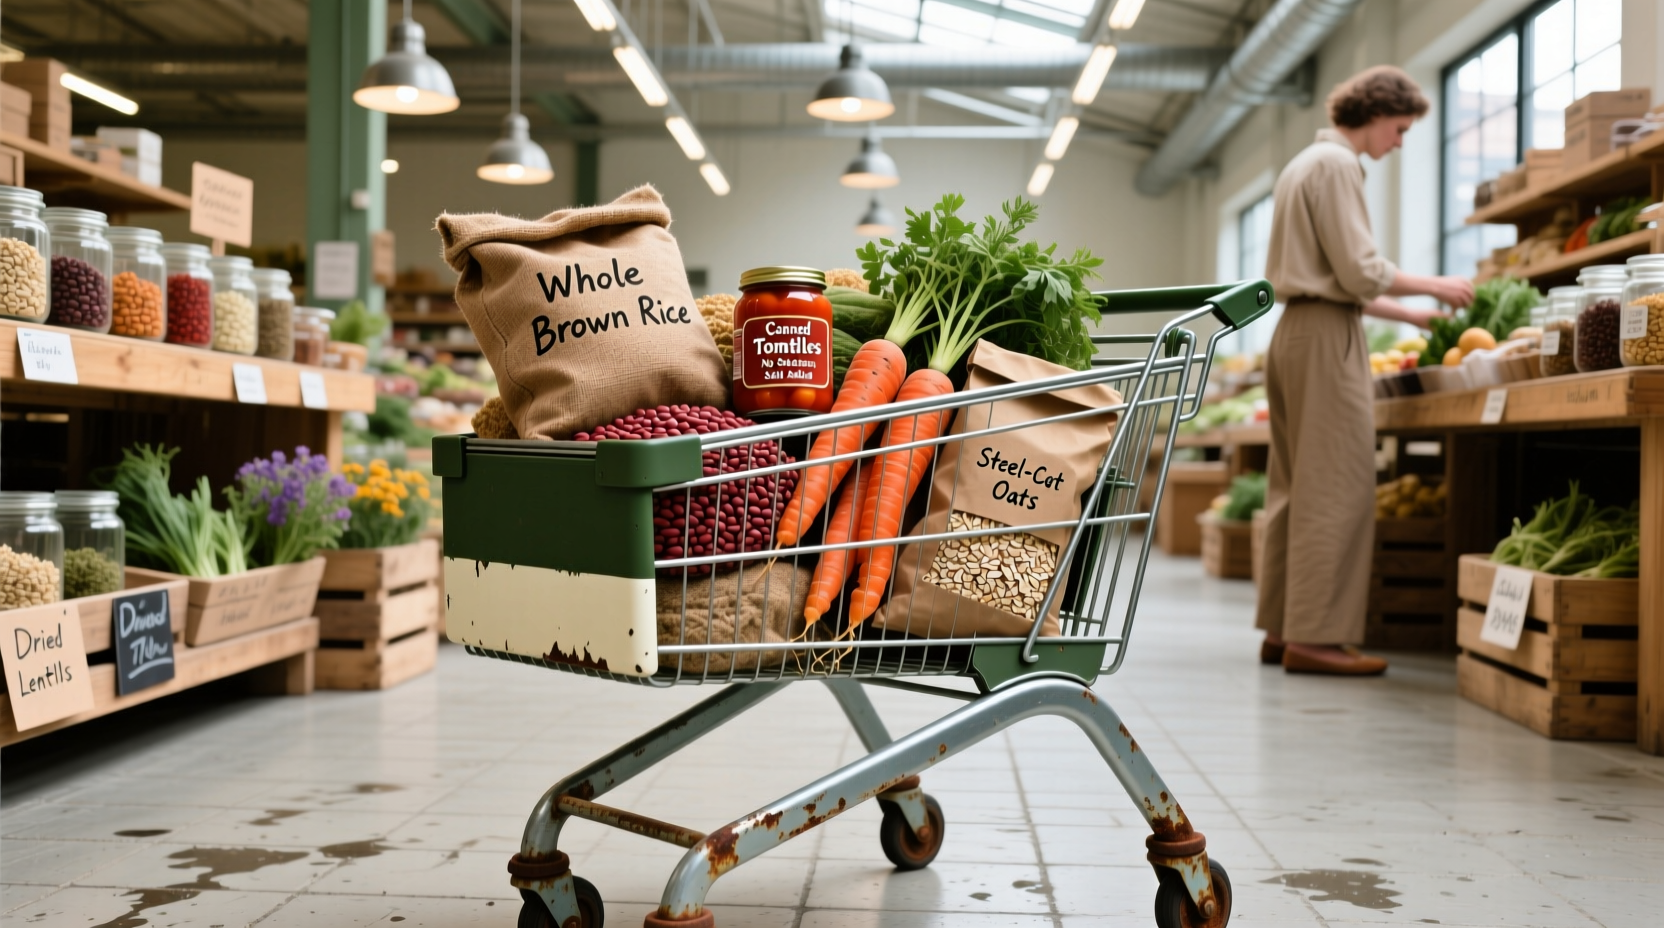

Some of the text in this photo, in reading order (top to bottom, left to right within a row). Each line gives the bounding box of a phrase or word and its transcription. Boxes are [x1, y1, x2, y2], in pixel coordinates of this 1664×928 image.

[536, 258, 644, 303] Whole
[532, 295, 691, 356] Brown Rice
[765, 321, 811, 336] Canned
[992, 480, 1039, 510] Oats
[14, 623, 63, 660] Dried
